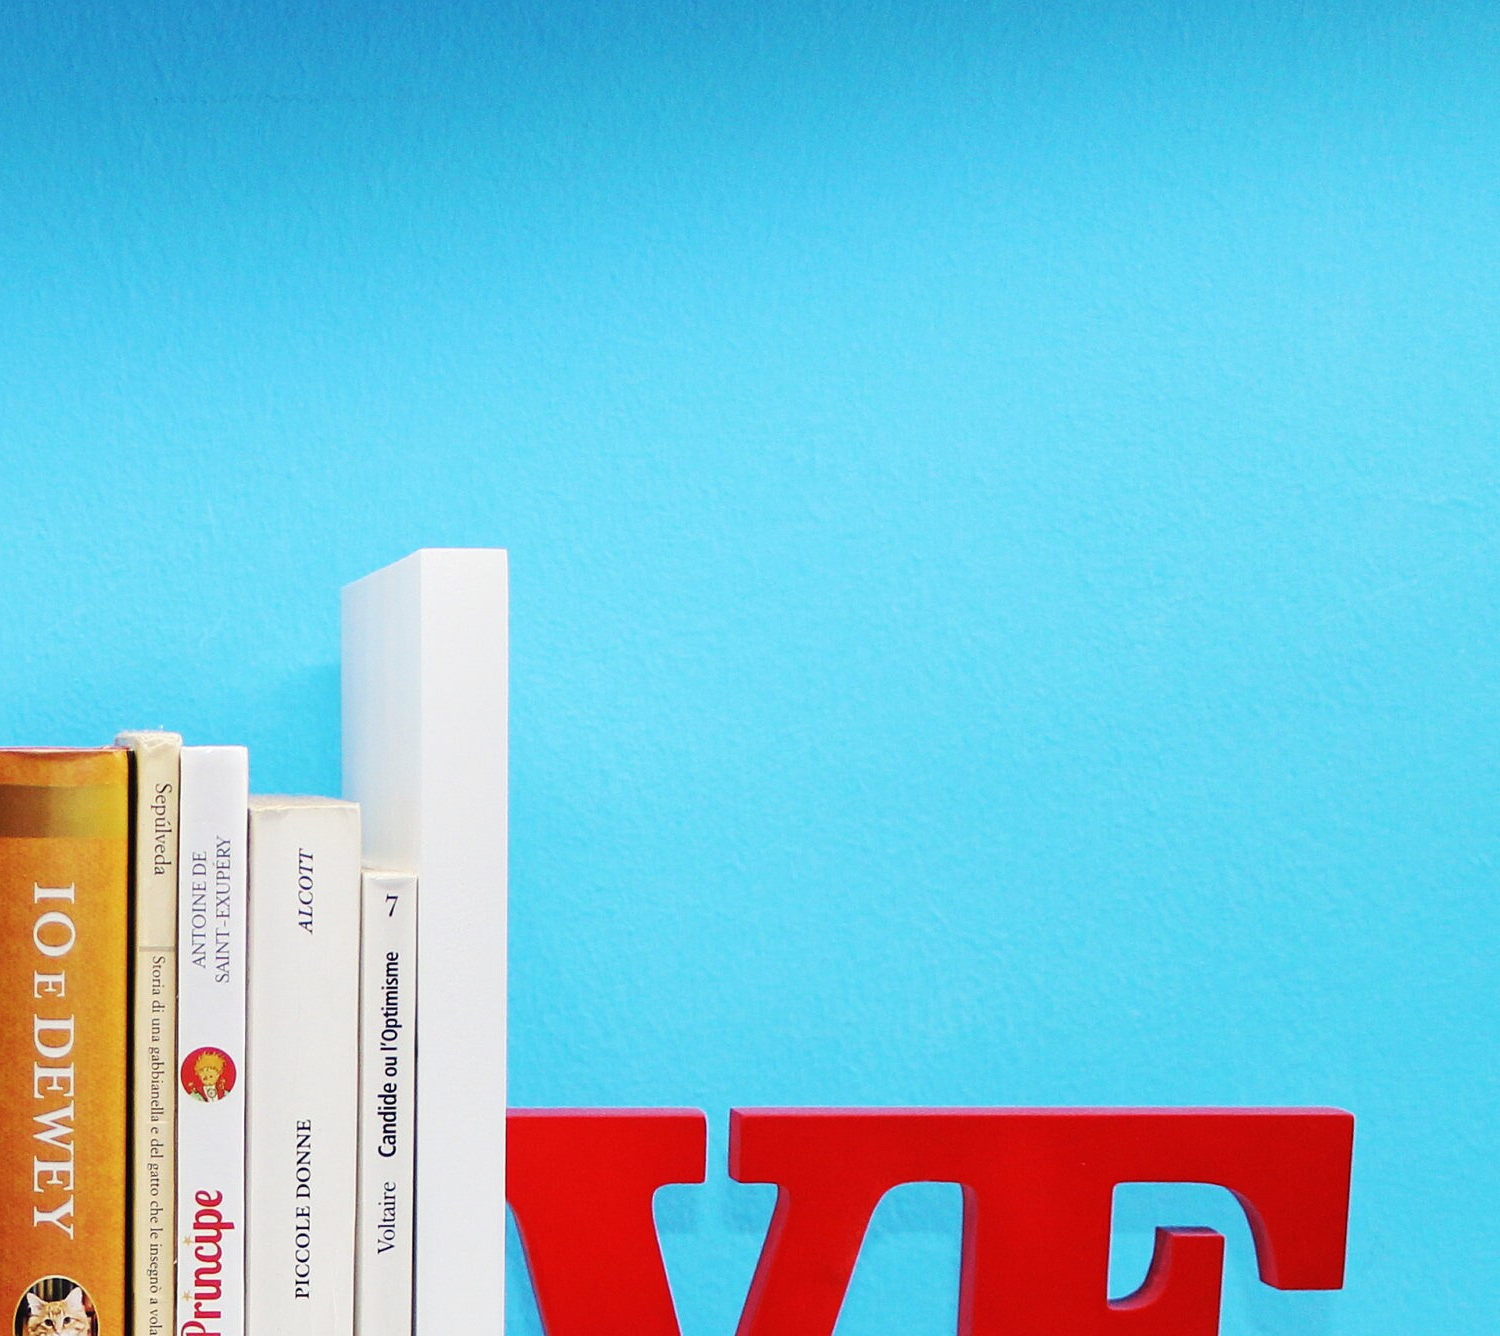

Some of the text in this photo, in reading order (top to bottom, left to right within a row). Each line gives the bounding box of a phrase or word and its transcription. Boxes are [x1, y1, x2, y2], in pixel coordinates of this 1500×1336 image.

[150, 783, 172, 875] Sepúlveda
[191, 850, 207, 969] ANTOINE DE
[212, 835, 231, 984] SAINT-EXUPÉRY
[298, 848, 314, 935] ALCOTT
[385, 894, 399, 917] 7
[152, 956, 166, 995] Storia
[151, 998, 165, 1013] di
[151, 1017, 160, 1042] una
[33, 882, 76, 1240] IO E DEWEY
[384, 1055, 398, 1077] ou
[148, 1047, 165, 1122] gabbianella
[150, 1126, 159, 1134] e
[377, 1082, 398, 1158] Candide
[150, 1138, 164, 1158] del
[147, 1163, 162, 1197] gatto
[149, 1200, 164, 1223] che
[295, 1118, 312, 1300] PICCOLE DONNE
[377, 1181, 397, 1254] Voltaire
[149, 1227, 164, 1241] le
[146, 1243, 163, 1294] insegnò
[149, 1297, 158, 1305] a
